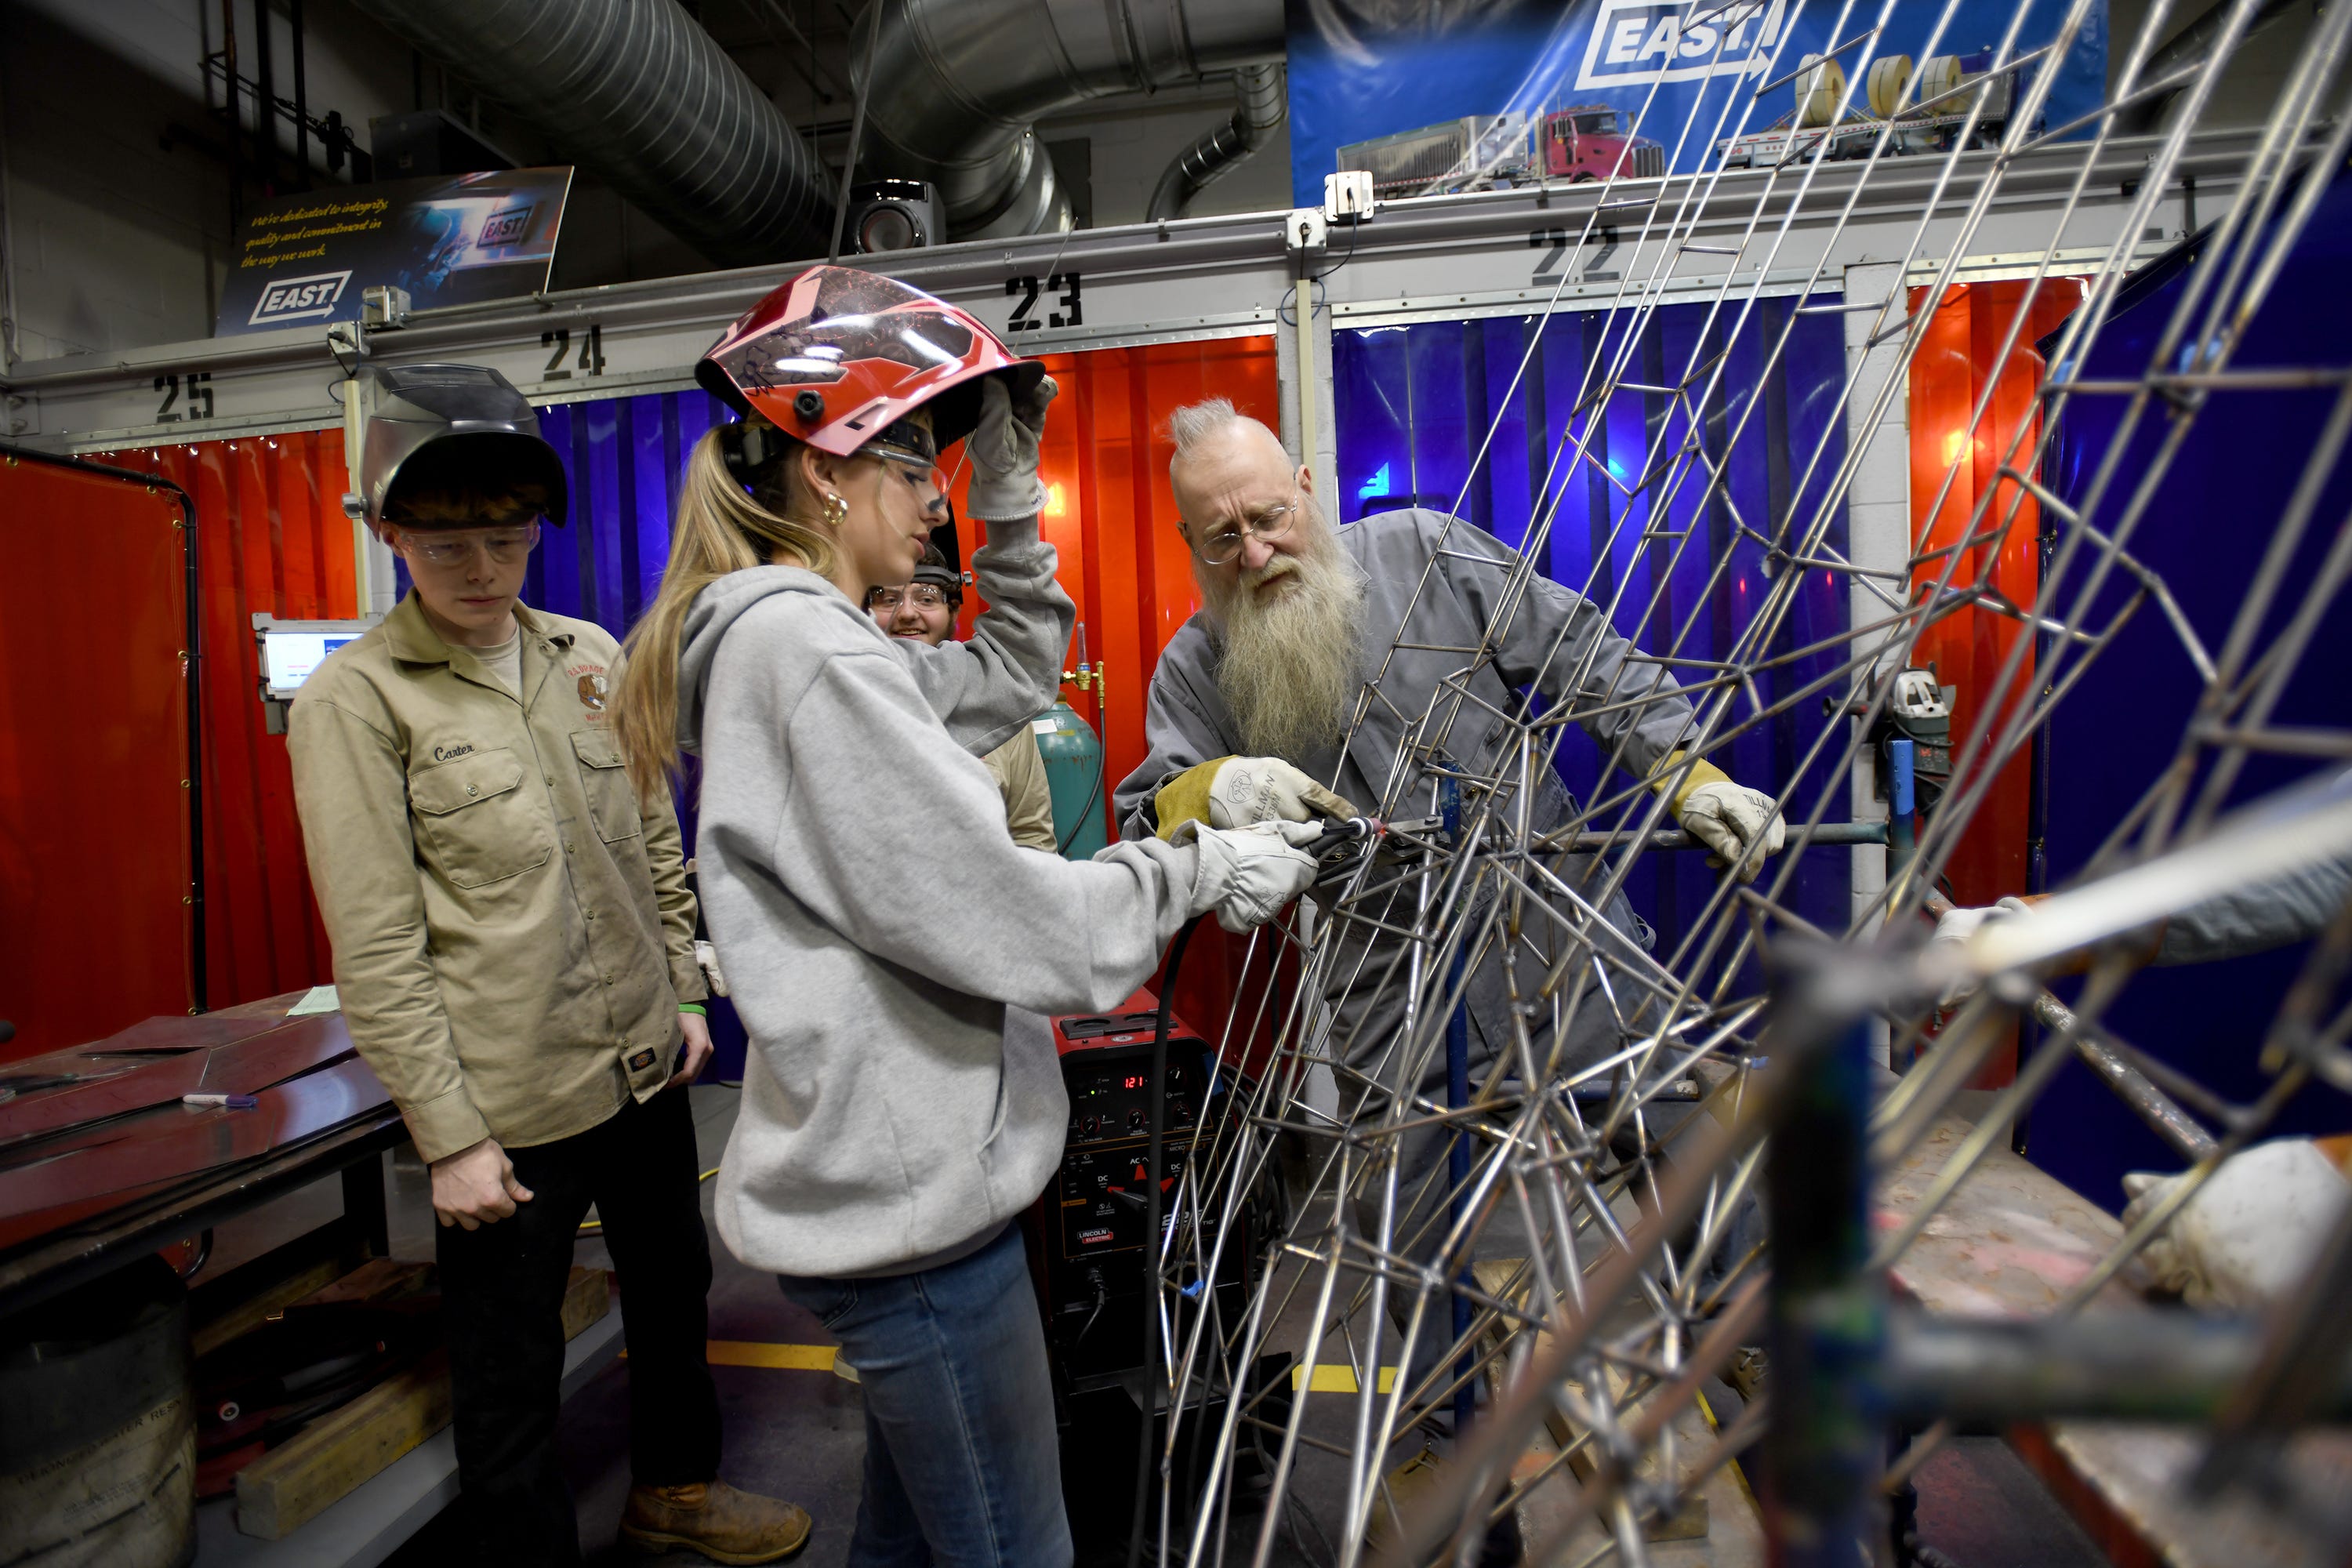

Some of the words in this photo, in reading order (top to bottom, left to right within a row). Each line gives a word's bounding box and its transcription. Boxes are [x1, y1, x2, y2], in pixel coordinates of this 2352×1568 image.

[252, 212, 280, 227] We're
[280, 201, 332, 223] dedicated
[328, 203, 342, 215] to
[485, 216, 524, 238] EAST
[245, 232, 281, 252] quality
[281, 226, 307, 242] and
[303, 220, 369, 238] commitment
[369, 218, 383, 229] in
[241, 253, 259, 268] the
[259, 254, 281, 269] way
[281, 251, 298, 261] we
[298, 243, 326, 259] work
[1530, 225, 1620, 286] 22
[263, 283, 336, 312] EAST
[1006, 272, 1082, 332] 23
[541, 324, 605, 381] 24
[154, 372, 214, 423] 25
[434, 745, 475, 762] Carter
[1123, 1076, 1144, 1089] 121
[1078, 1229, 1107, 1239] LINCOLN
[1085, 1234, 1111, 1243] ELECTRIC
